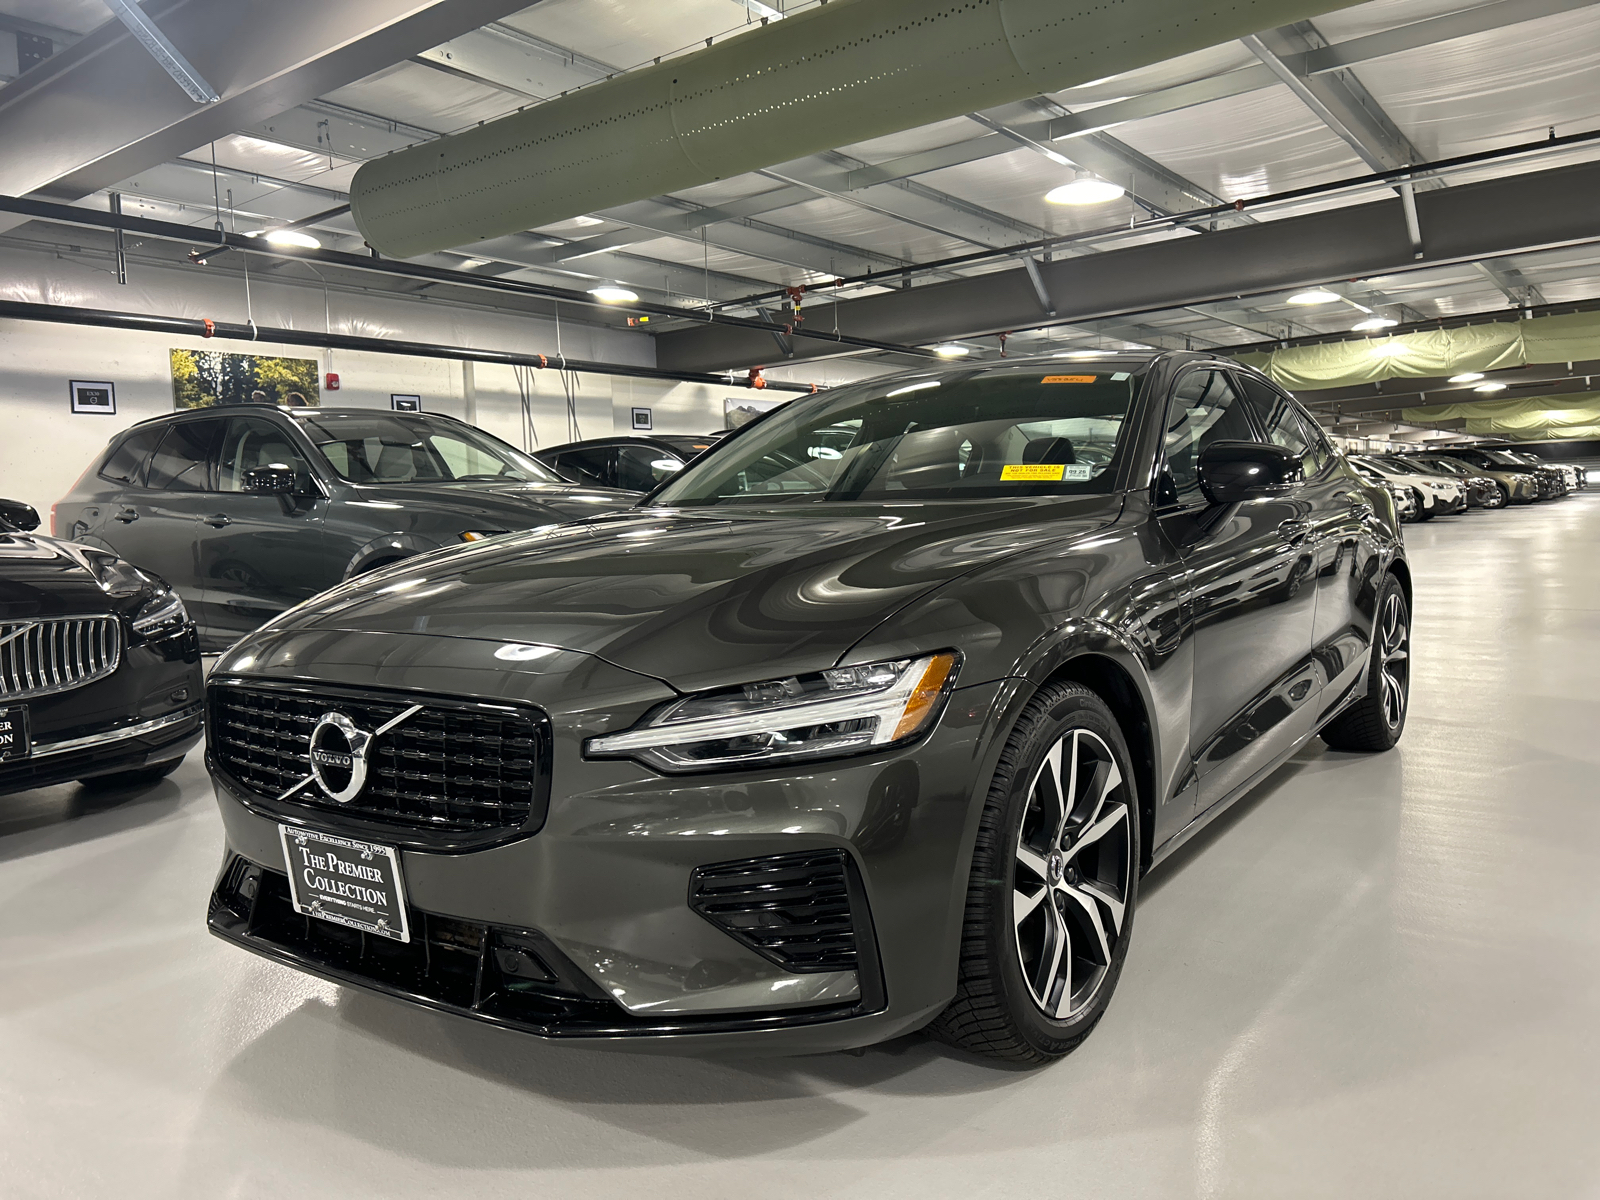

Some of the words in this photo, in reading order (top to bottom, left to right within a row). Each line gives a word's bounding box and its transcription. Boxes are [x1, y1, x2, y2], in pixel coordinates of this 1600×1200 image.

[313, 751, 351, 766] VOLVO
[319, 833, 351, 846] EXCELLENCE
[352, 841, 369, 851] SINCE
[370, 843, 386, 855] 1995
[299, 846, 327, 870] THE
[326, 852, 384, 884] PREMIER
[303, 868, 388, 907] COLLECTION
[319, 894, 347, 907] EVERYTHING
[346, 901, 363, 912] STARTS
